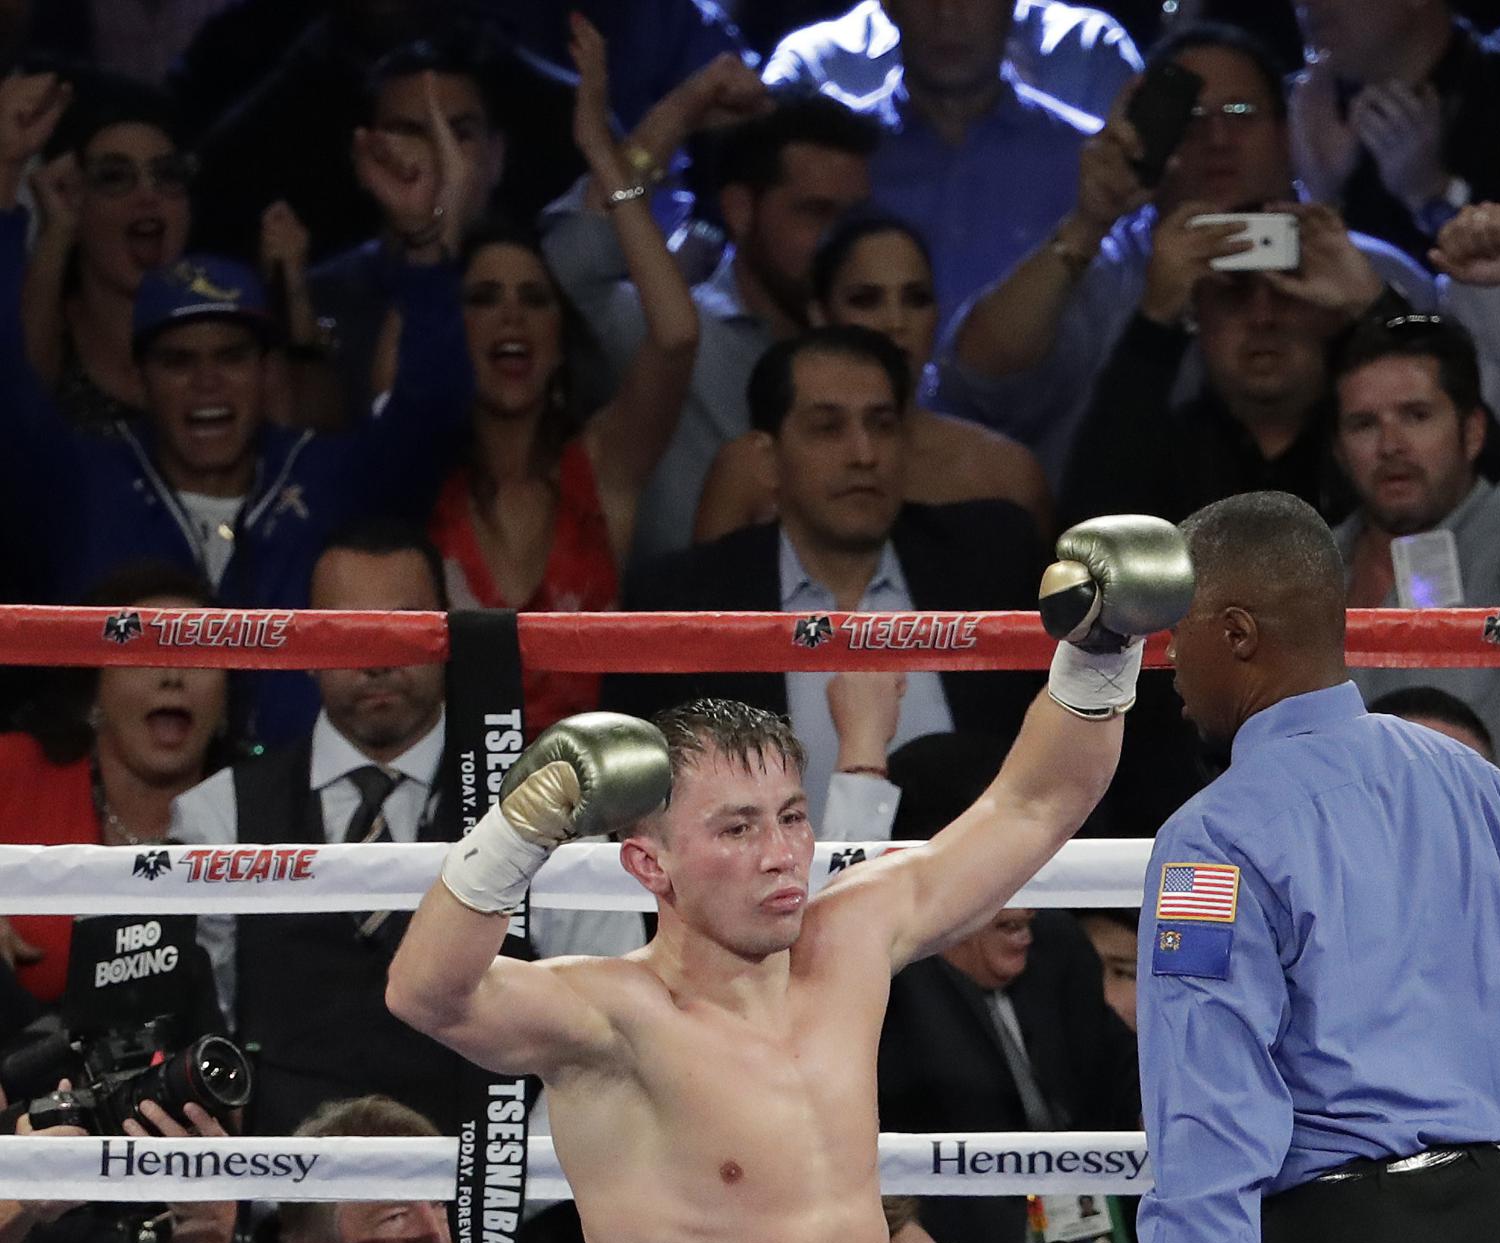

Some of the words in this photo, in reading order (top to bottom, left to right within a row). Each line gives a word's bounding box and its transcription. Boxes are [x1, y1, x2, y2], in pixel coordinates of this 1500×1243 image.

[152, 612, 294, 649] TECATE
[842, 615, 983, 650] TECATE
[178, 849, 319, 883] TECATE
[115, 920, 162, 954] HBO
[94, 945, 179, 988] BOXING
[99, 1141, 319, 1182] Hennessy
[459, 1120, 476, 1181] TODAY.
[932, 1141, 1149, 1178] Hennessy
